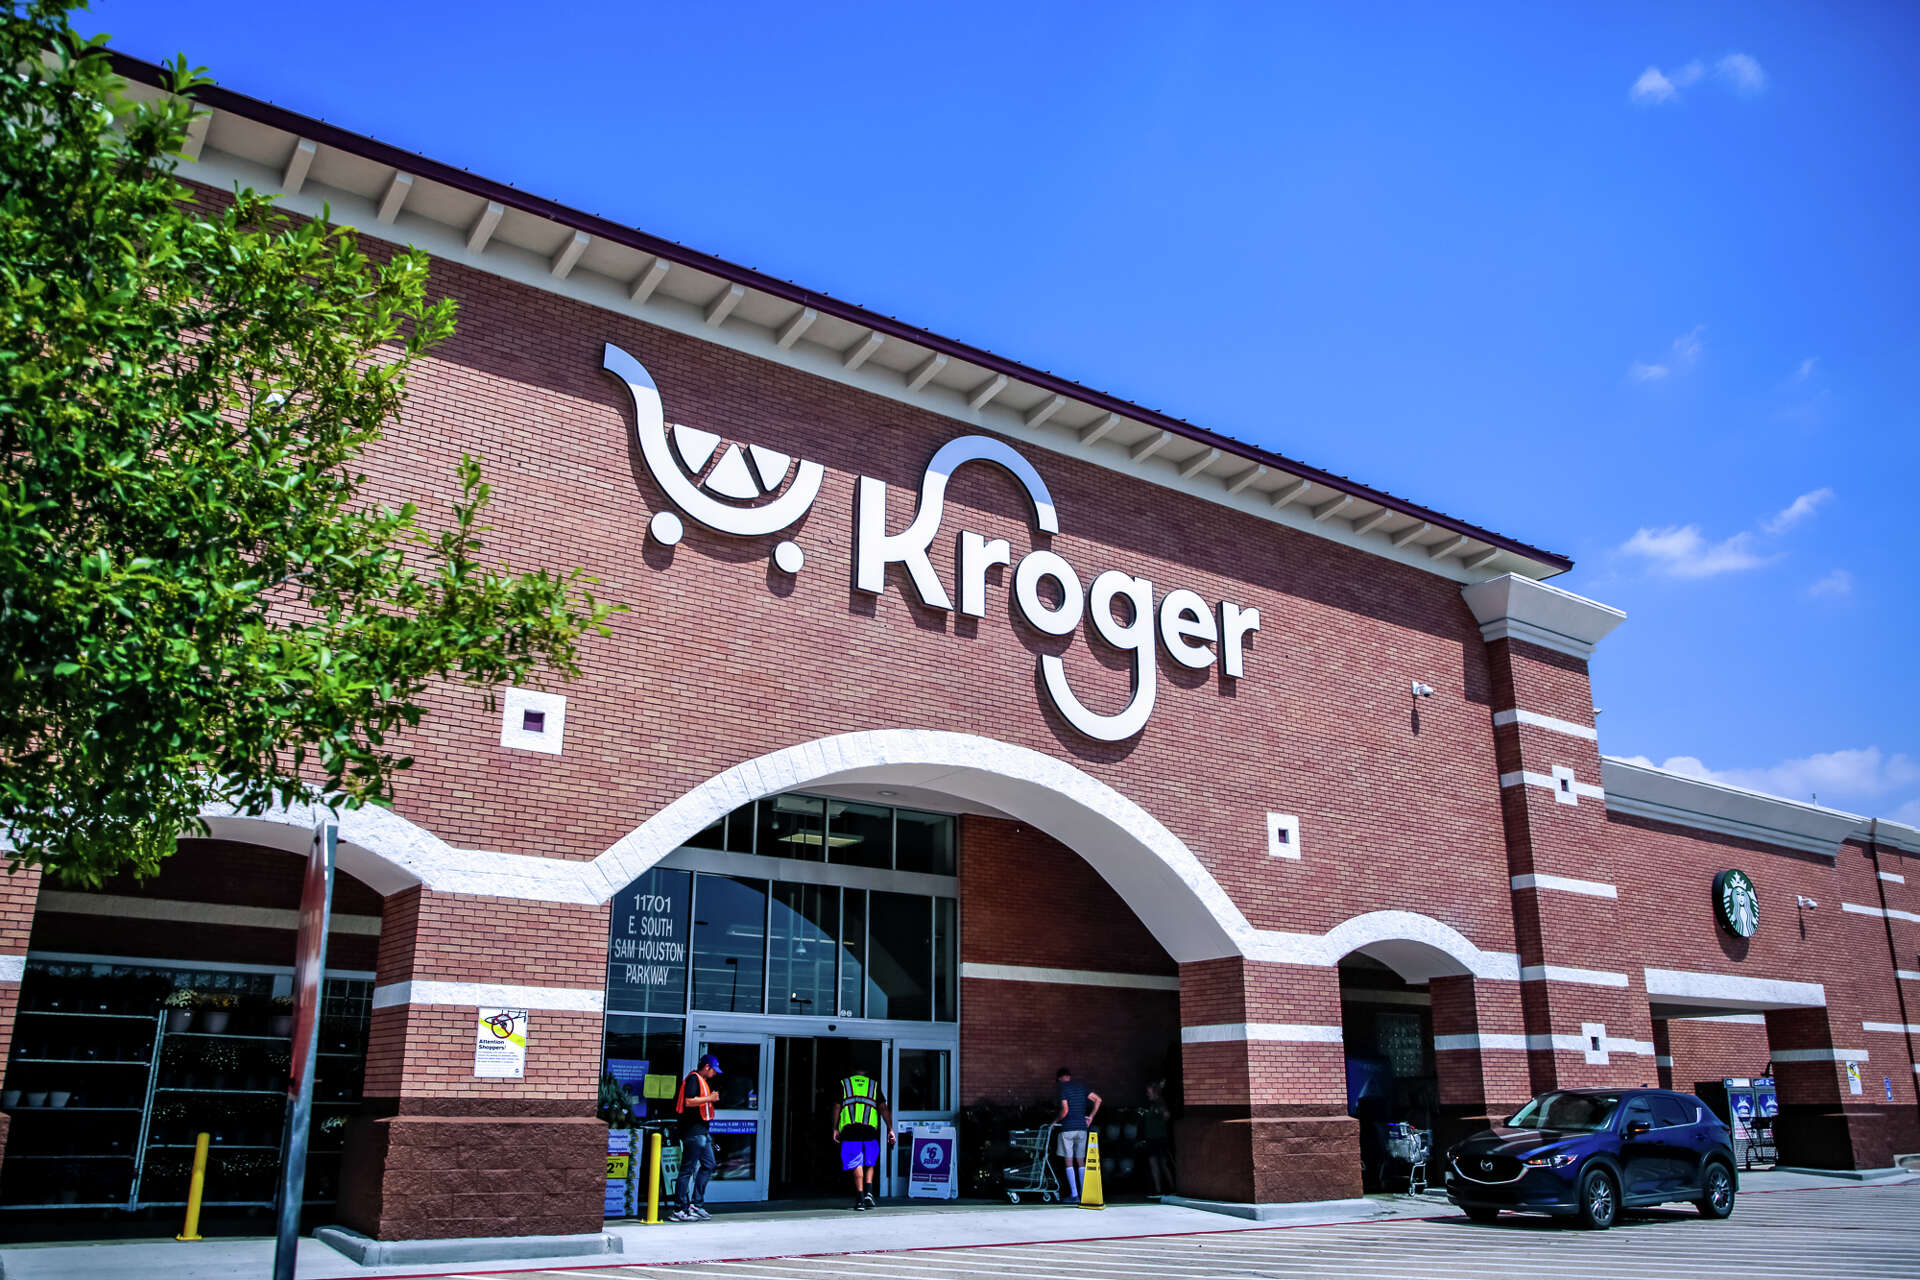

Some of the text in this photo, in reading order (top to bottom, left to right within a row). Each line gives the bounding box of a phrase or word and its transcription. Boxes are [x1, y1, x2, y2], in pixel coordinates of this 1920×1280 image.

[857, 434, 1261, 742] Kroger
[634, 894, 672, 913] 11701
[628, 915, 673, 937] E. SOUTH
[614, 938, 684, 962] SAM HOUSTON
[625, 964, 670, 986] PARKWAY
